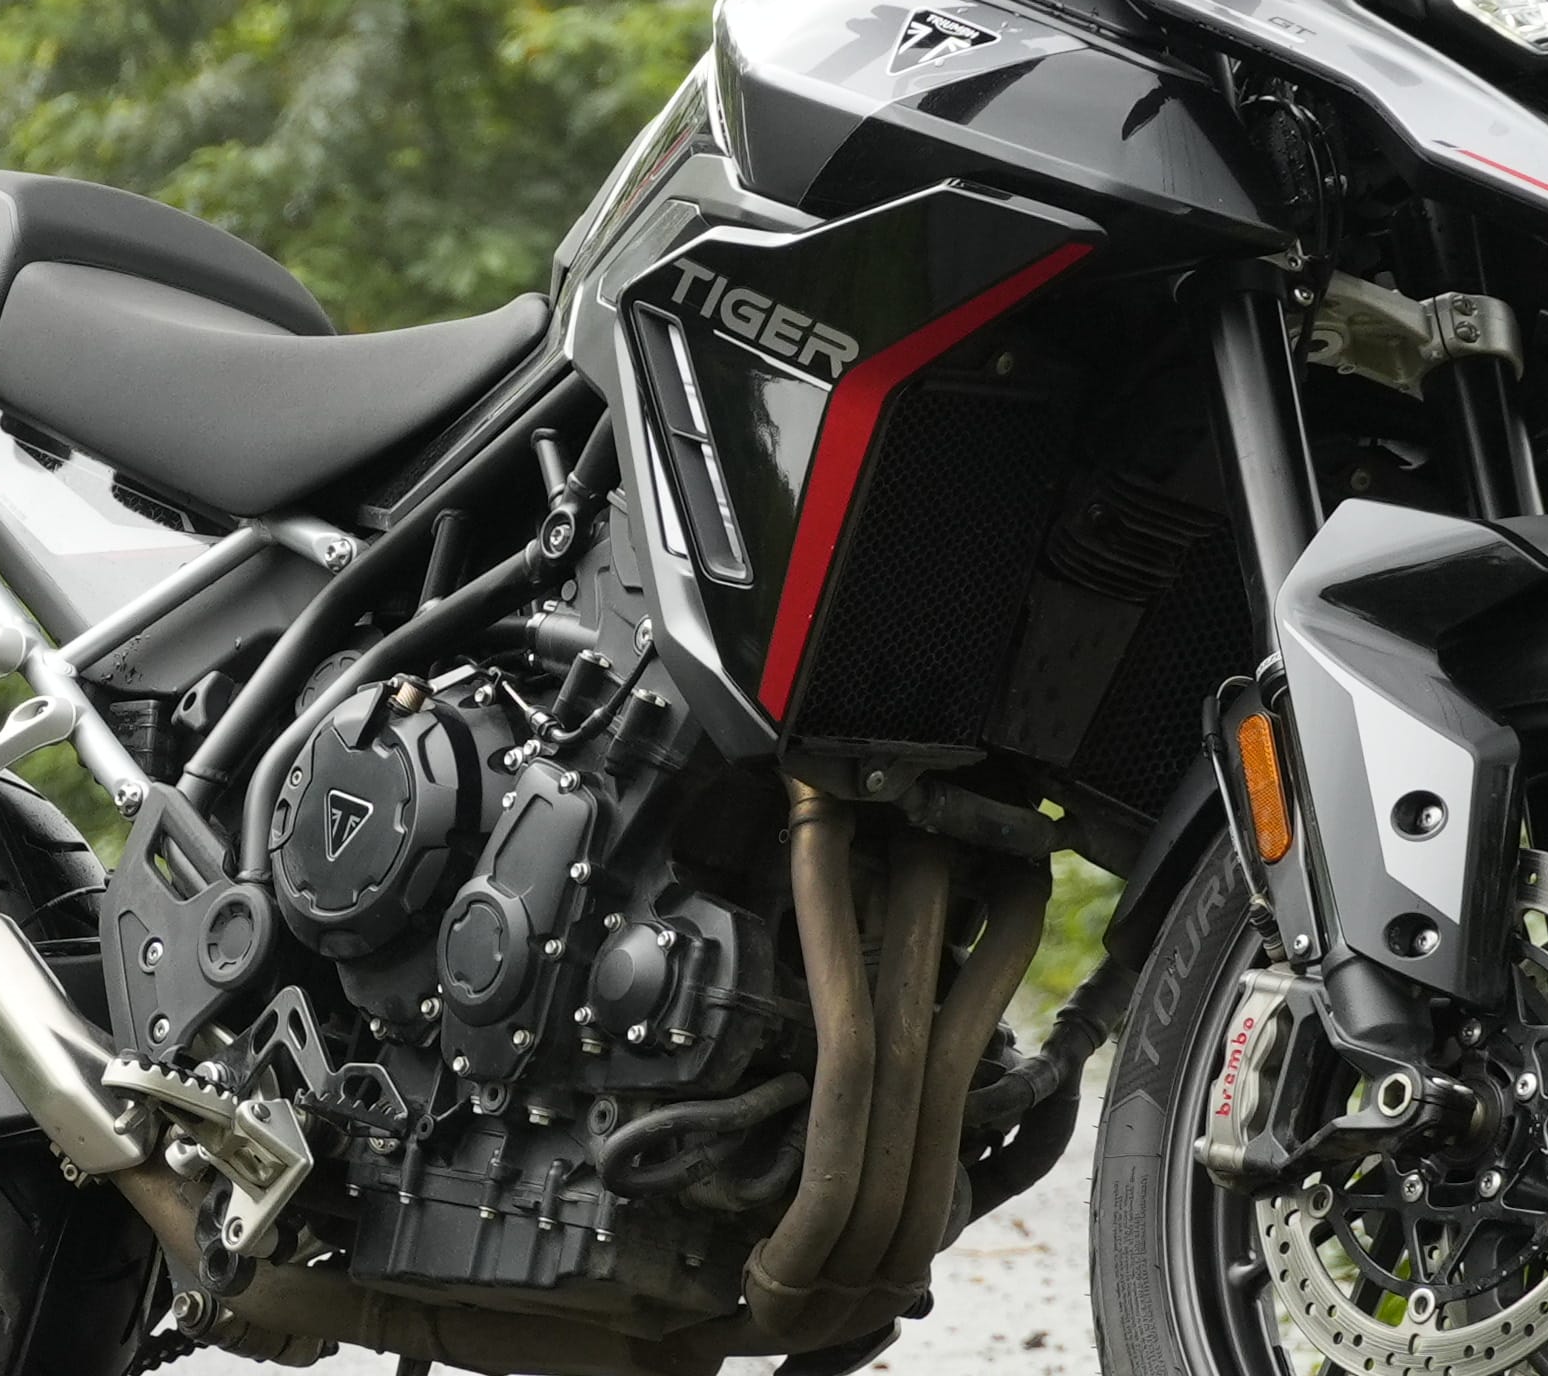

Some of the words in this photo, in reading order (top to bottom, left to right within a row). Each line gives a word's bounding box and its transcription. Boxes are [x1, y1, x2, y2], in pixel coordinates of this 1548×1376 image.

[925, 12, 981, 42] TRIUMPH
[1268, 15, 1318, 39] GT
[671, 256, 861, 379] TIGER
[1215, 1016, 1255, 1118] brembo
